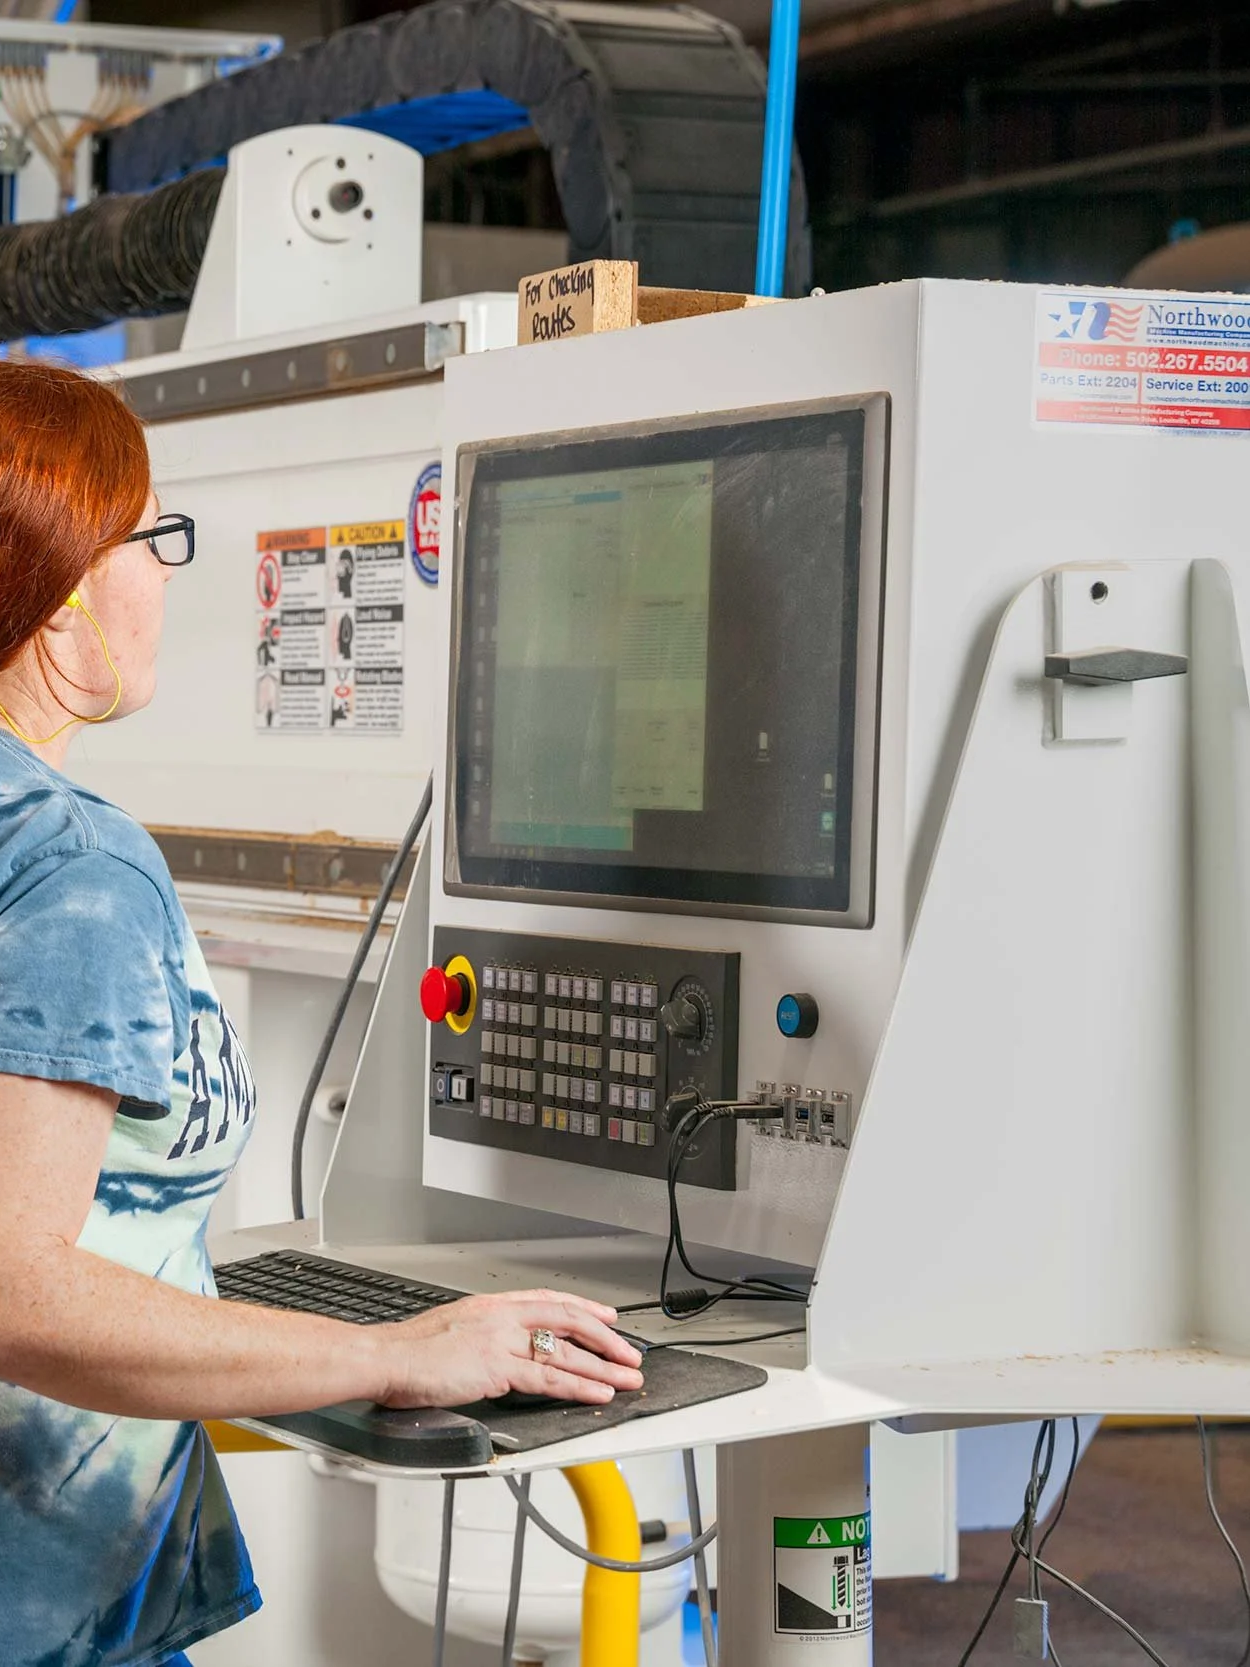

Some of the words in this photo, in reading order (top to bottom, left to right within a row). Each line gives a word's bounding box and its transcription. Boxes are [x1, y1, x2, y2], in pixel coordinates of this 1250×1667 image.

[525, 279, 543, 308] For
[549, 266, 595, 306] Checking
[532, 304, 576, 341] Routes
[1060, 351, 1120, 367] Phone:
[1126, 352, 1248, 373] 502.267.5504
[1040, 373, 1073, 386] Parts
[1078, 374, 1102, 387] Ext:
[1106, 376, 1137, 389] 2204
[1146, 378, 1193, 391] Service
[1197, 380, 1222, 392] Ext:
[1225, 382, 1250, 393] 200
[348, 526, 385, 541] CAUTION
